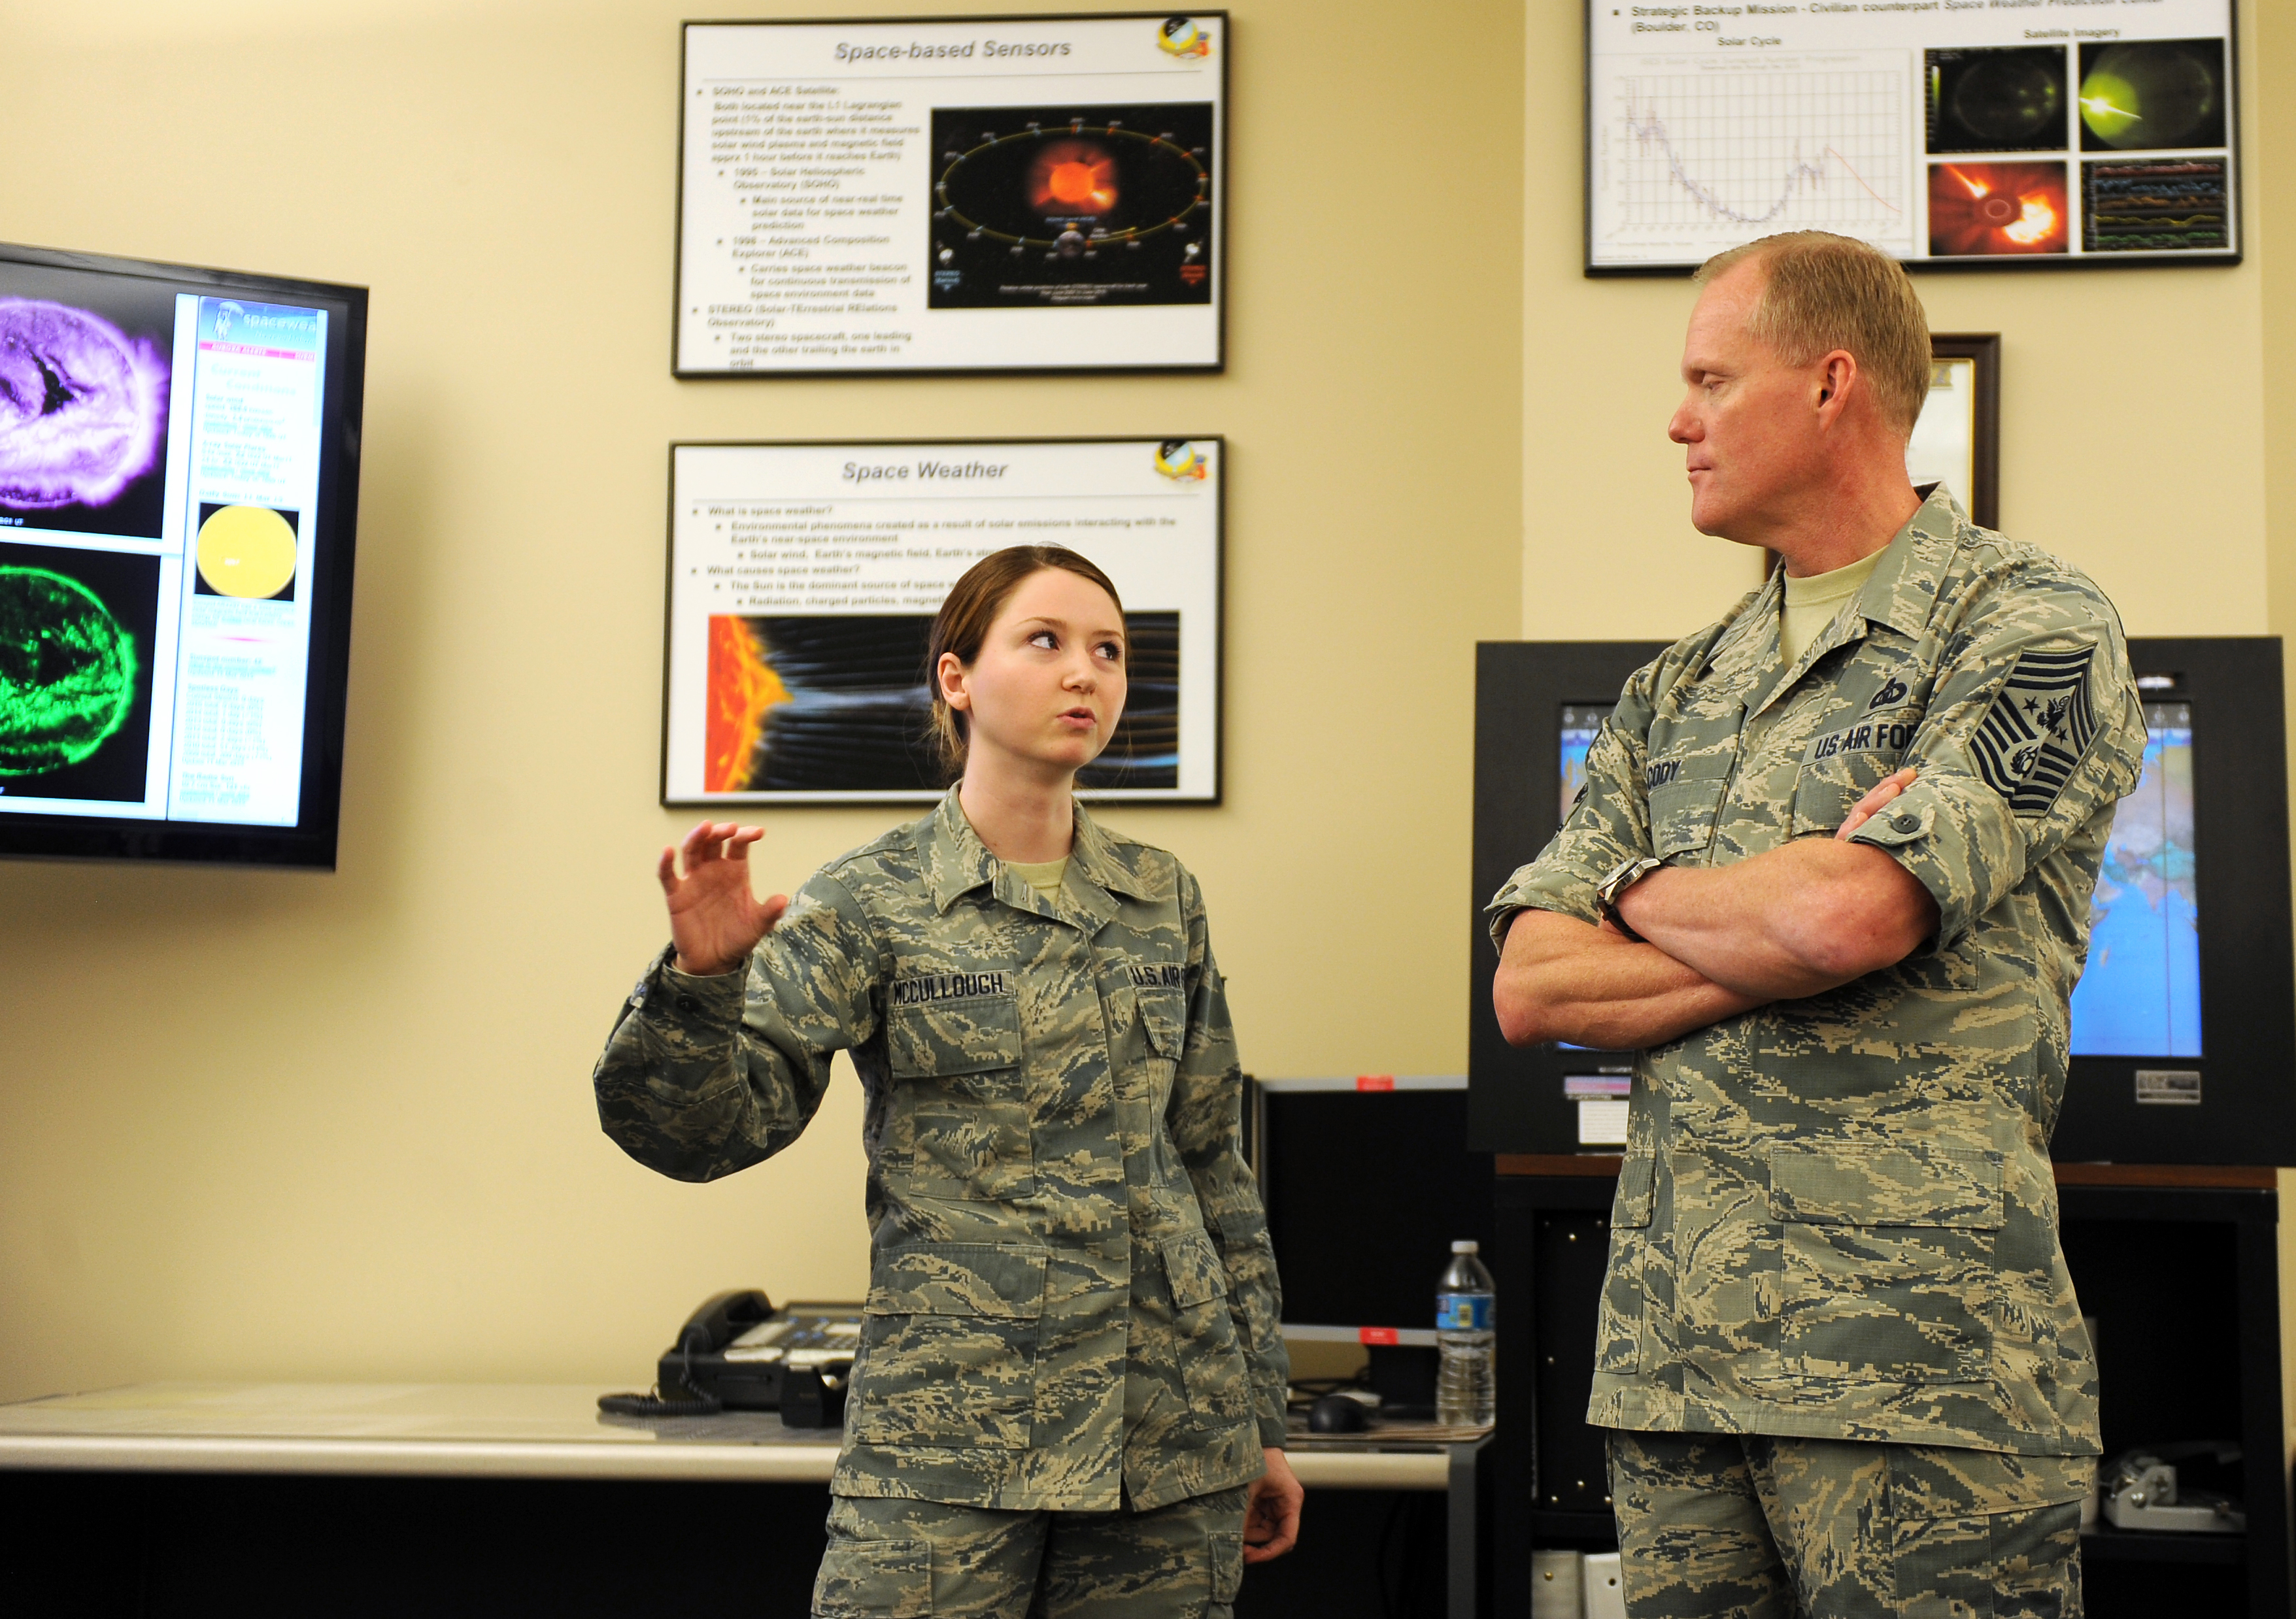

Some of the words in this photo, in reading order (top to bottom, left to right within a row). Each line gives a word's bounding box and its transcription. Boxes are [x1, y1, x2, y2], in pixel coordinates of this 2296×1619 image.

[1632, 5, 1689, 18] Strategic
[1693, 4, 1742, 18] Backup
[1747, 3, 1797, 14] Mission
[1810, 2, 1858, 13] Civilian
[1862, 2, 1940, 13] counterpart
[1632, 21, 1691, 34] (Boulder,
[1696, 20, 1720, 32] CO)
[2025, 28, 2070, 39] Satellite
[2074, 27, 2120, 39] Imagery
[1717, 36, 1746, 46] Solar
[1750, 35, 1781, 47] Cycle
[836, 41, 975, 63] Space-based
[983, 40, 1072, 58] Sensors
[748, 86, 767, 95] and
[741, 101, 780, 110] located
[808, 100, 824, 110] the
[764, 114, 774, 123] of
[777, 114, 793, 123] the
[764, 127, 774, 136] of
[777, 127, 793, 136] the
[796, 126, 822, 136] earth
[826, 126, 856, 135] where
[711, 140, 738, 150] solar
[741, 139, 765, 149] wind
[768, 139, 805, 150] plasma
[808, 139, 828, 148] and
[830, 138, 879, 150] magnetic
[881, 137, 903, 147] field
[752, 152, 777, 161] hour
[779, 151, 812, 161] before
[826, 150, 866, 161] reaches
[769, 167, 796, 176] Solar
[752, 194, 777, 204] Main
[819, 193, 829, 204] of
[880, 193, 903, 203] time
[752, 208, 778, 217] solar
[781, 207, 803, 217] data
[806, 207, 820, 217] for
[824, 209, 855, 218] space
[858, 207, 900, 216] weather
[752, 221, 805, 231] prediction
[768, 235, 820, 245] Advanced
[823, 234, 890, 246] Composition
[732, 248, 776, 259] Explorer
[751, 263, 788, 273] Carries
[792, 265, 822, 275] space
[826, 263, 866, 272] weather
[869, 262, 907, 271] beacon
[751, 276, 764, 286] for
[768, 276, 827, 286] continuous
[830, 275, 898, 285] transmission
[900, 275, 911, 284] of
[751, 291, 781, 301] space
[784, 289, 849, 299] environment
[853, 288, 875, 297] data
[730, 332, 752, 342] Two
[755, 333, 788, 342] stereo
[873, 331, 912, 342] leading
[730, 346, 749, 355] and
[752, 345, 769, 355] the
[771, 345, 799, 355] other
[802, 344, 838, 356] trailing
[841, 344, 858, 354] the
[861, 344, 887, 354] earth
[890, 344, 900, 353] in
[843, 461, 909, 483] Space
[917, 460, 1009, 479] Weather
[708, 506, 735, 516] What
[738, 507, 747, 516] is
[751, 508, 782, 518] space
[785, 505, 833, 515] weather?
[731, 520, 807, 531] Environmental
[811, 520, 872, 533] phenomena
[875, 520, 915, 529] created
[942, 520, 971, 529] result
[975, 519, 985, 528] of
[989, 518, 1014, 528] solar
[1018, 518, 1072, 527] emissions
[1075, 517, 1131, 529] interacting
[1135, 517, 1156, 527] with
[1160, 516, 1177, 526] the
[731, 533, 768, 544] Earth's
[832, 533, 898, 543] environment
[750, 549, 776, 559] Solar
[815, 549, 852, 559] Earth's
[855, 548, 903, 560] magnetic
[936, 547, 972, 558] Earth's
[707, 565, 734, 575] What
[777, 567, 809, 577] space
[812, 563, 860, 575] weather?
[731, 580, 749, 590] The
[753, 580, 773, 590] Sun
[776, 580, 785, 590] is
[788, 580, 804, 590] the
[808, 579, 858, 590] dominant
[861, 581, 897, 590] source
[900, 579, 911, 589] of
[914, 581, 944, 592] space
[749, 595, 802, 607] Radiation,
[805, 595, 848, 608] charged
[851, 595, 899, 607] particles,
[1814, 733, 1839, 759] U.S.
[1842, 726, 1871, 752] AIR
[1647, 759, 1681, 790] CODY
[1130, 965, 1162, 986] U.S.
[894, 973, 1004, 1005] MCCULLOUGH
